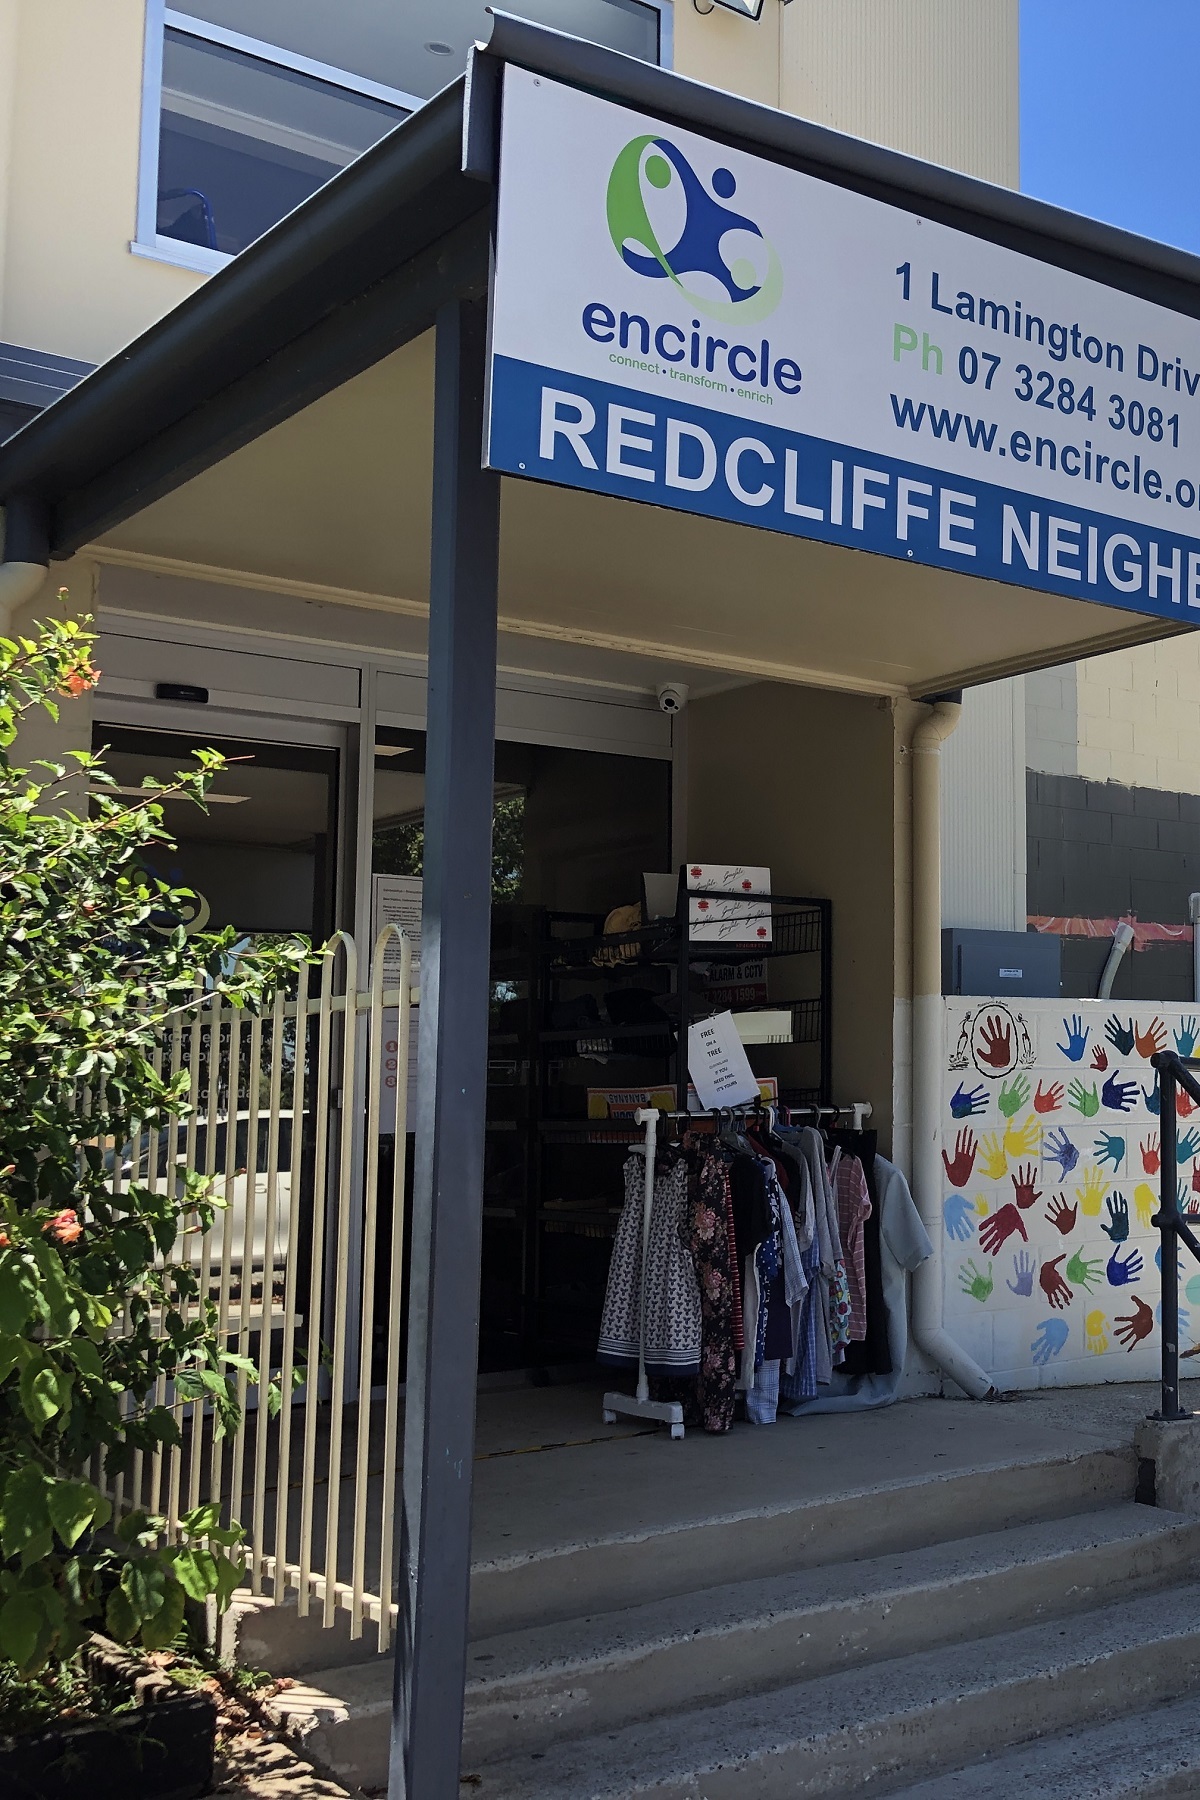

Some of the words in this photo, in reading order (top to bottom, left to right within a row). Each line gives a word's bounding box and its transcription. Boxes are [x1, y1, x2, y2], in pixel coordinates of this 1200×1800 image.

[895, 261, 911, 301] 1
[931, 271, 1124, 373] Lamington
[582, 302, 802, 395] encircle
[608, 353, 660, 375] connect
[669, 367, 728, 393] transform
[737, 387, 774, 406] enrich
[893, 322, 943, 376] Ph
[958, 345, 1002, 391] 07
[1014, 363, 1097, 422] 3284
[1108, 393, 1180, 450] 3081
[539, 386, 977, 557] REDCLIFFE
[709, 967, 735, 982] ALARM
[737, 966, 743, 979] &
[744, 964, 764, 979] CCTV
[735, 987, 756, 1002] 1599
[700, 1028, 715, 1038] FREE
[707, 1047, 722, 1057] TREE
[608, 1093, 646, 1103] BANANAS
